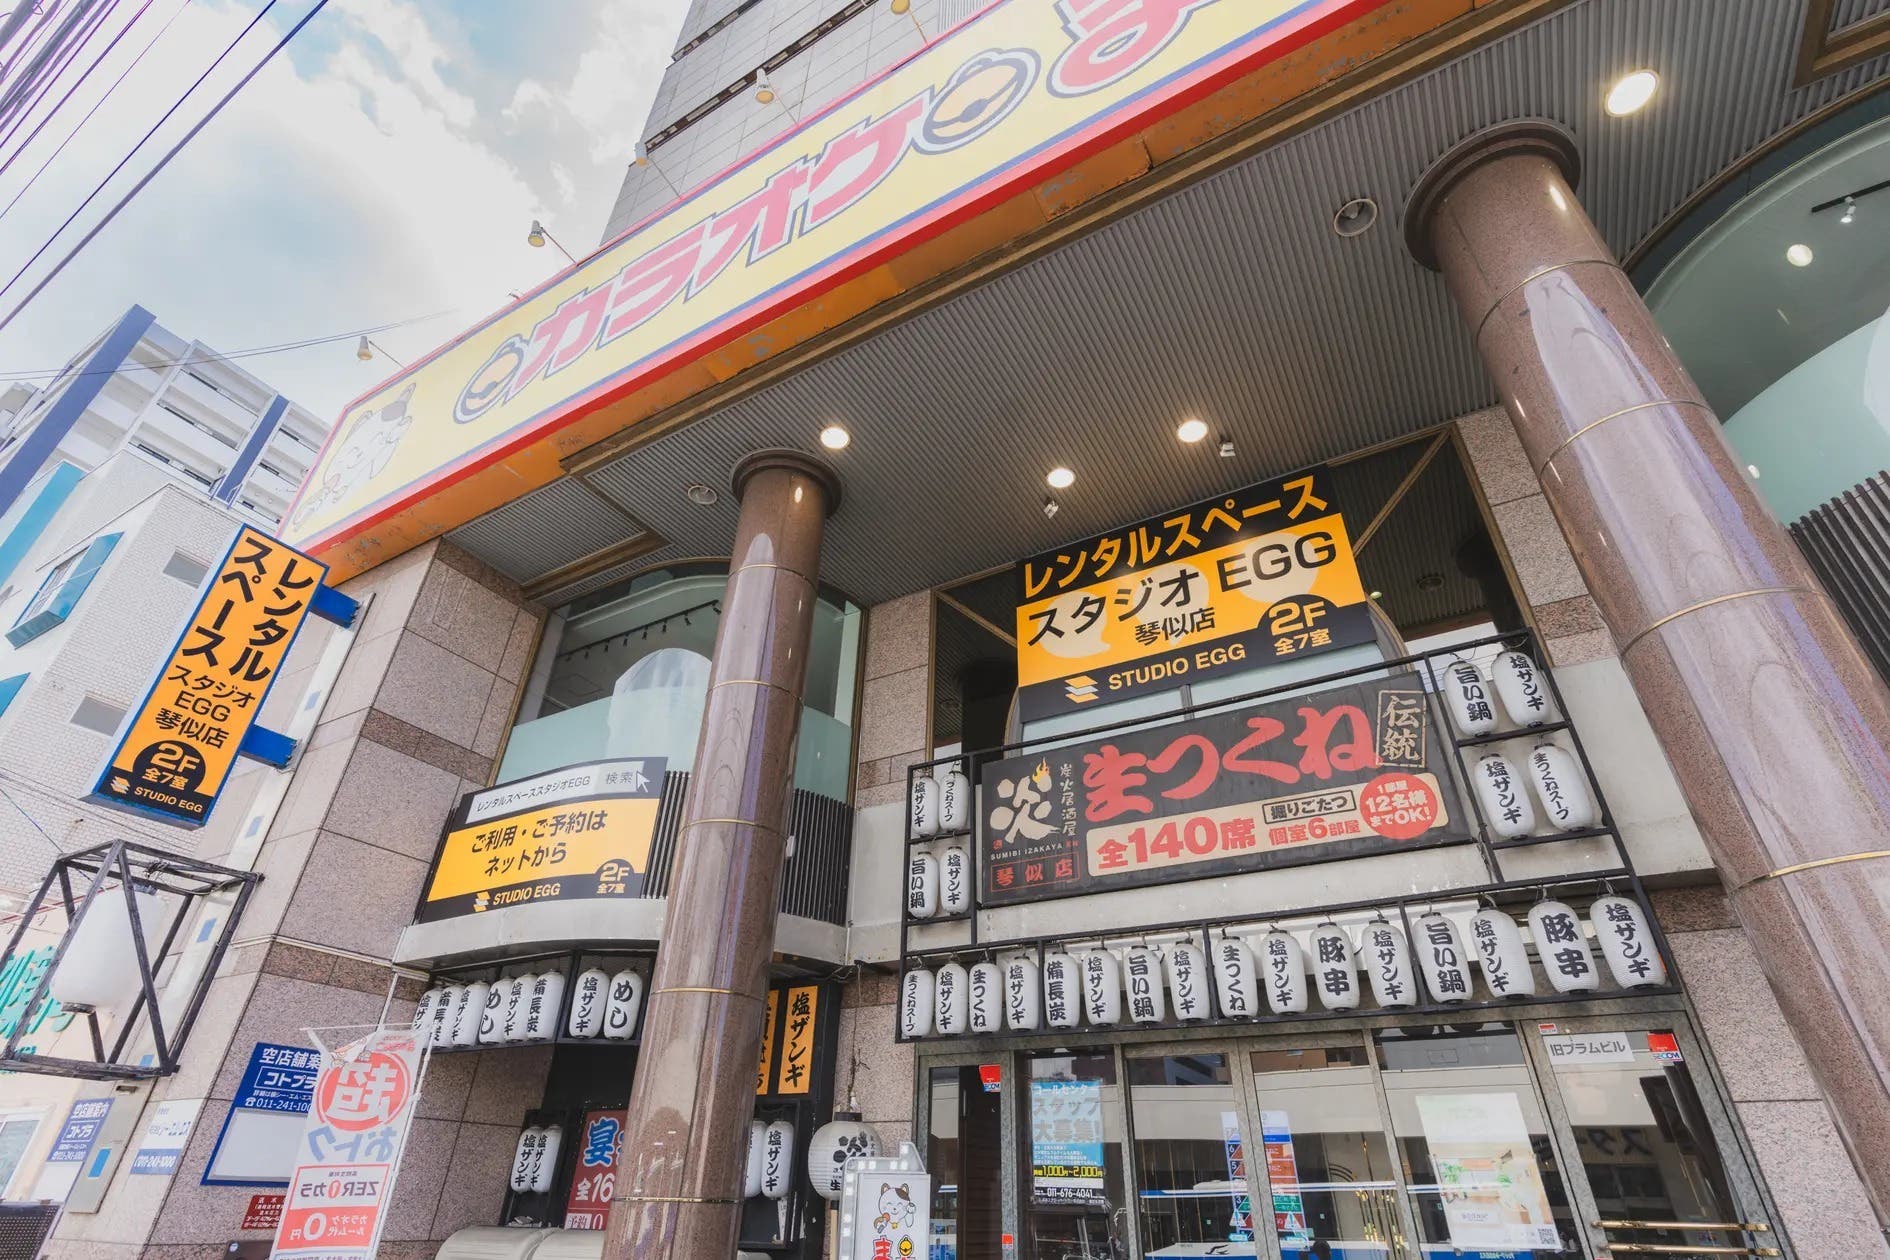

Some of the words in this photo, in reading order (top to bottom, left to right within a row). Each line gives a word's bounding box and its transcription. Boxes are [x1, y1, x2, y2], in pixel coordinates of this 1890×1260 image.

[505, 93, 928, 401] カラオケ
[1024, 475, 1328, 598] レンタルスペース
[182, 537, 272, 667] スペース
[1028, 569, 1199, 646] スタジオ
[1217, 531, 1337, 592] EGG
[229, 558, 313, 681] レンタル
[1135, 606, 1216, 645] 琴似店
[1268, 601, 1327, 636] 2F
[1274, 628, 1332, 656] 全7室
[168, 665, 255, 708] スタジオ
[1109, 643, 1189, 690] STUDIO
[1196, 643, 1246, 670] EGG
[174, 691, 231, 722] EGG
[156, 708, 229, 748] 琴似店
[1381, 694, 1423, 766] 伝統
[150, 743, 199, 772] 2F
[605, 771, 633, 785] 検索
[142, 767, 189, 790] 全7室
[134, 786, 177, 805] STUDIO
[178, 799, 203, 813] EGG
[1060, 763, 1077, 836] 炭火居酒屋
[1270, 792, 1350, 819] 掘りごたつ
[1096, 816, 1257, 869] 全140席
[1268, 817, 1361, 845] 個室6部屋
[485, 842, 567, 876] ネットから
[600, 863, 630, 881] 2F
[991, 850, 1021, 861] SUMIBI
[1025, 843, 1063, 855] IZAKAYA
[493, 887, 533, 905] STUDIO
[534, 883, 561, 898] EGG
[597, 882, 625, 893] 全7室
[1317, 936, 1350, 996] 豚串
[1540, 913, 1589, 979] 豚串
[414, 994, 431, 1029] 塩ザン
[481, 988, 501, 1035] めし
[575, 977, 598, 1032] 塩ザンギ
[609, 981, 633, 1029] めし
[1047, 961, 1067, 1021] 備長炭
[259, 1047, 321, 1068] 空店舗案
[785, 992, 811, 1087] 塩ザンギ
[583, 1117, 624, 1167] 宴
